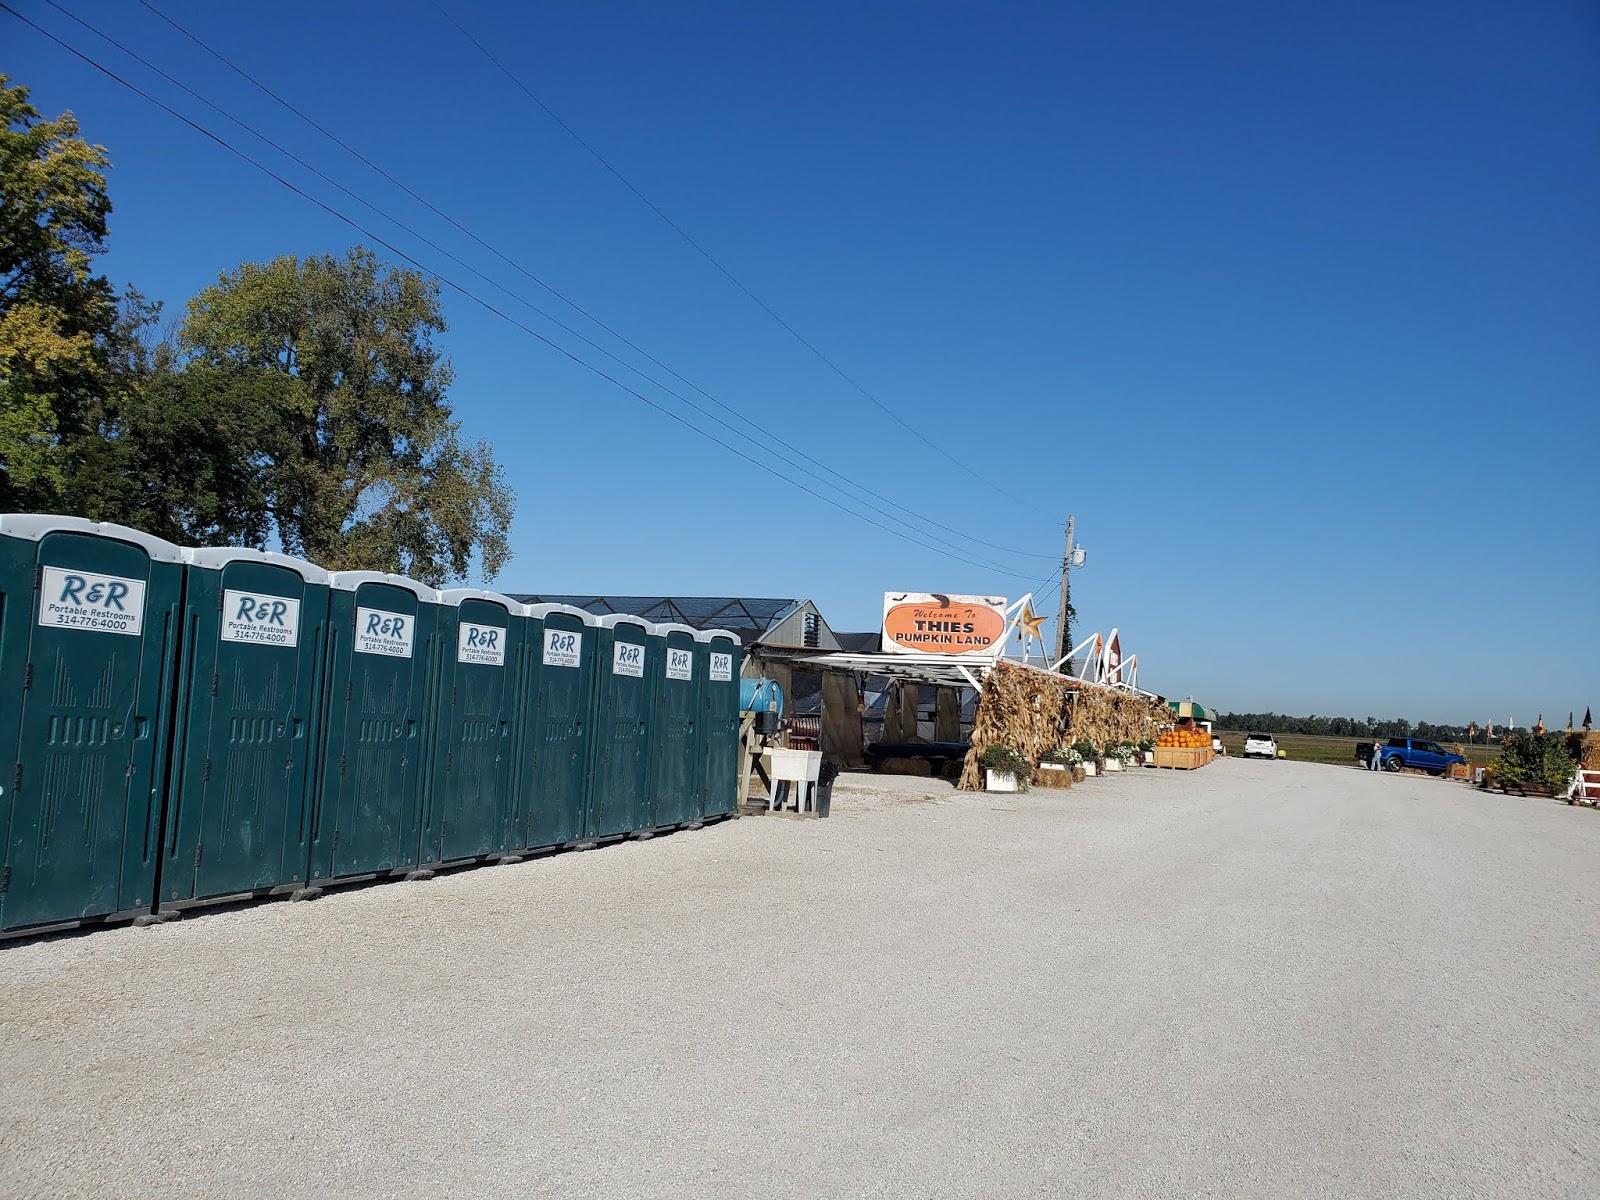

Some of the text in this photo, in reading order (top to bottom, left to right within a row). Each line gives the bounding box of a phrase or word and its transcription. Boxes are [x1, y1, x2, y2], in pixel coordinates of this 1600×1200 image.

[59, 575, 129, 611] R&R
[48, 604, 136, 621] Portable Restrooms
[236, 595, 287, 626] R&R
[914, 609, 977, 619] Welcome To
[228, 622, 293, 635] Portable Restrooms
[366, 613, 405, 639] R&R
[914, 620, 975, 633] THIES
[360, 635, 381, 644] Portable
[467, 627, 498, 650] R&R
[550, 633, 575, 653] R&R
[896, 633, 991, 645] PUMPKIN LAND
[619, 645, 640, 664] R&R
[672, 652, 688, 668] R&R
[713, 655, 729, 670] R&R
